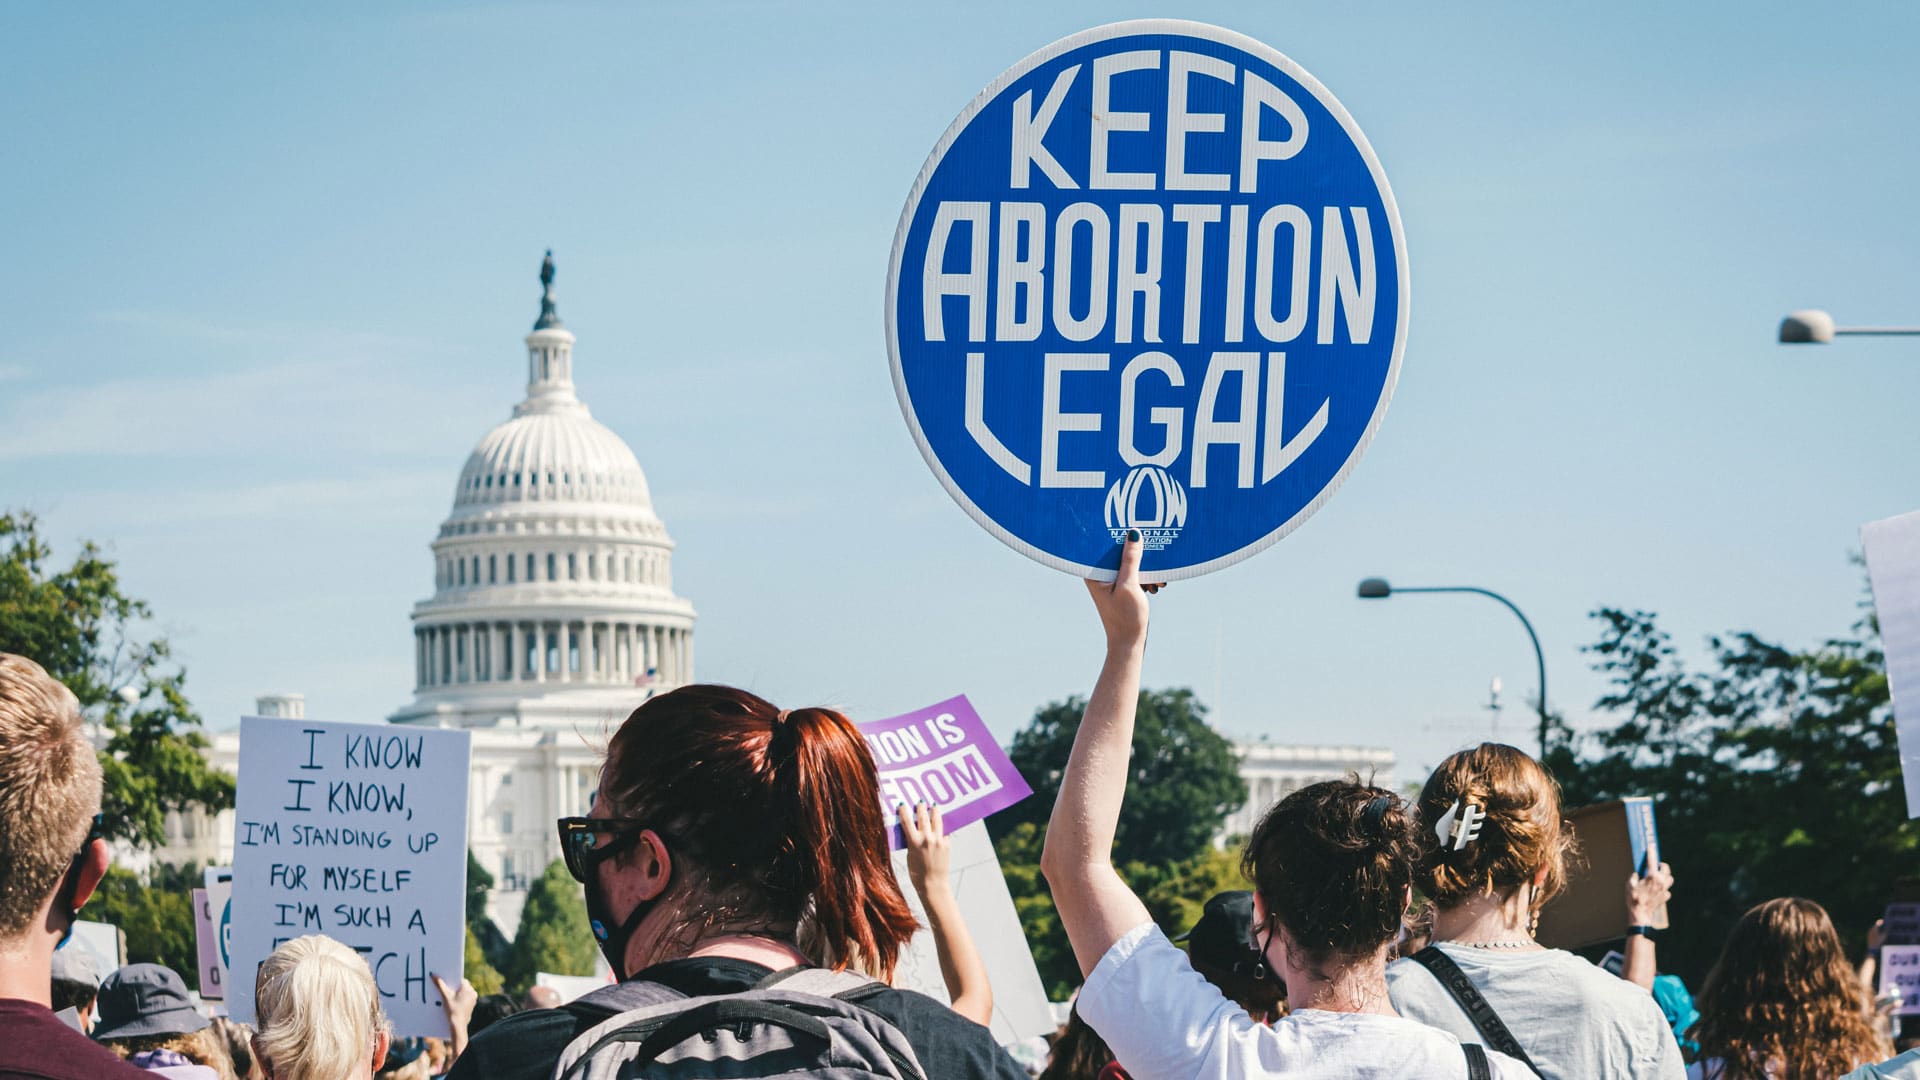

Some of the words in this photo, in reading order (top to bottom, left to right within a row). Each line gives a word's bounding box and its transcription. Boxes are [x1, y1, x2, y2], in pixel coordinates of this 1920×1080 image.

[1010, 50, 1309, 193] KEEP
[923, 201, 1377, 345] ABORTION
[965, 351, 1329, 488] LEGAL
[1104, 467, 1187, 528] NOW
[300, 729, 325, 769] I
[345, 734, 423, 769] KNOW
[925, 713, 966, 749] IS
[284, 779, 316, 811] I
[328, 781, 412, 821] KNOW,
[241, 821, 280, 846] I'M
[292, 825, 392, 849] STANDING
[408, 833, 439, 853] UP
[270, 864, 308, 891] FOR
[324, 867, 412, 893] MYSELF
[274, 902, 322, 931] I'M
[334, 905, 391, 928] SUCH
[408, 909, 426, 935] A
